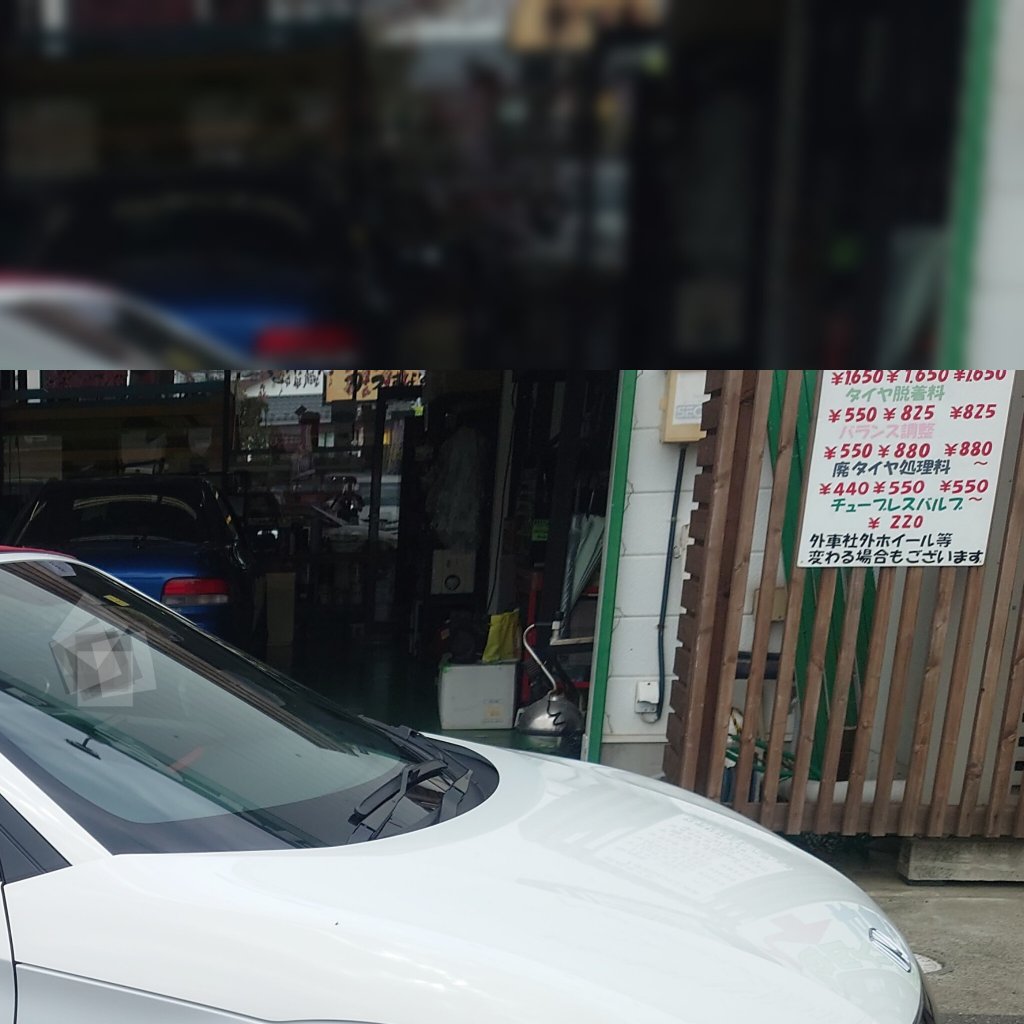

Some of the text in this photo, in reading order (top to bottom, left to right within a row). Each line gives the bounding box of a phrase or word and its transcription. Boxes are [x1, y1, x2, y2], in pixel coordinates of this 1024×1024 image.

[845, 385, 945, 402] タイヤ脱着料
[828, 406, 877, 423] ¥550
[950, 403, 997, 420] ¥825
[839, 423, 936, 440] バランス調整
[824, 443, 873, 460] ¥550
[944, 441, 993, 458] ¥880
[832, 459, 951, 478] 廃タイヤ処理料
[819, 481, 870, 497] ¥440
[939, 479, 990, 495] ¥550
[830, 496, 964, 513] チューブレスバルブ
[809, 532, 954, 549] 外車社外ホイール等
[807, 549, 985, 565] 変わる場合もございます
